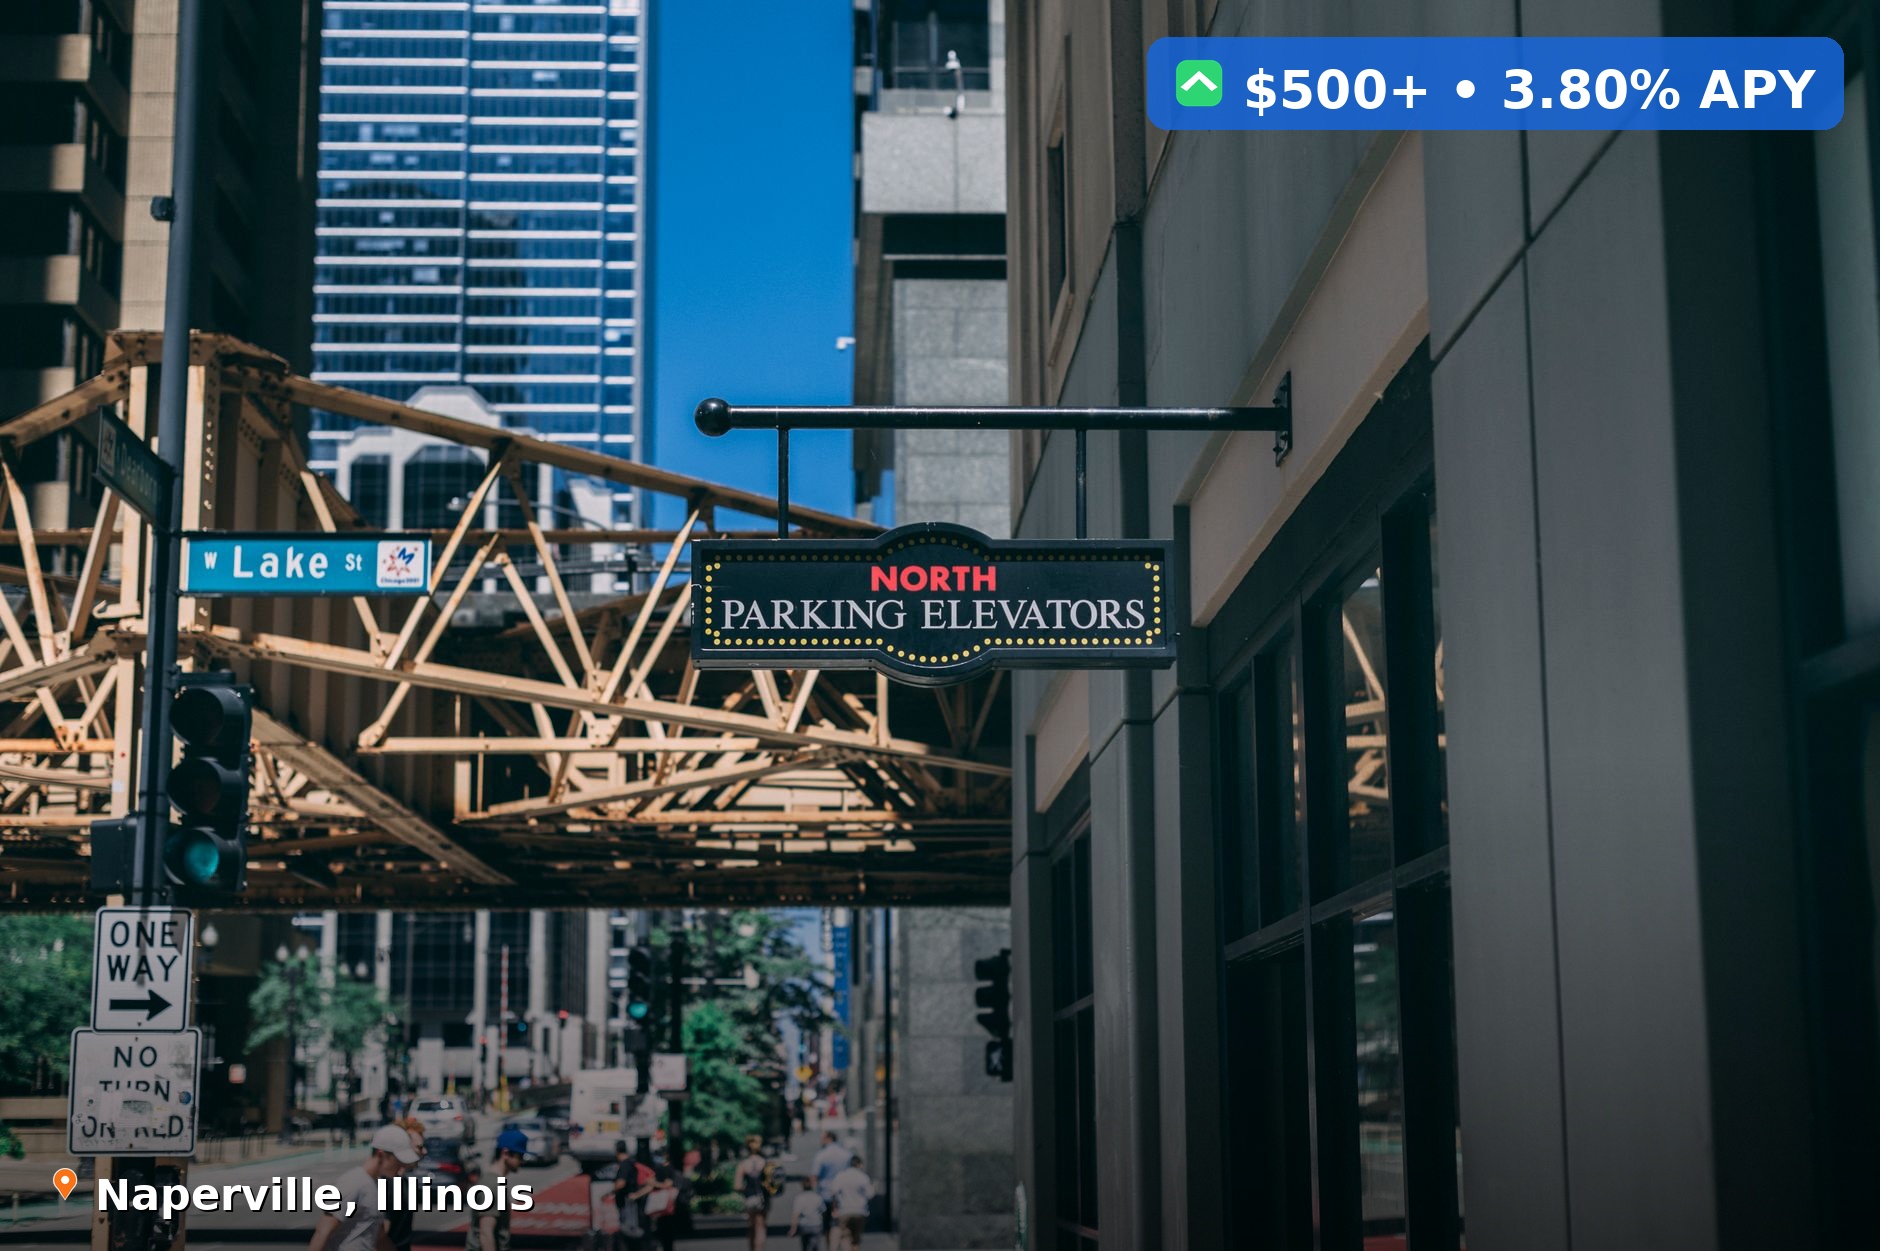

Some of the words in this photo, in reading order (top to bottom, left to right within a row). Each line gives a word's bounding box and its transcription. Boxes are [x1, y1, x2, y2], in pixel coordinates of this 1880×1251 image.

[204, 551, 217, 570] W
[233, 545, 328, 579] Lake
[345, 553, 362, 572] St
[871, 565, 997, 592] NORTH
[721, 597, 908, 633] PARKING
[920, 597, 1146, 631] ELEVATORS
[110, 921, 178, 948] ONE
[107, 955, 178, 982] WAY
[114, 1046, 157, 1068] NO
